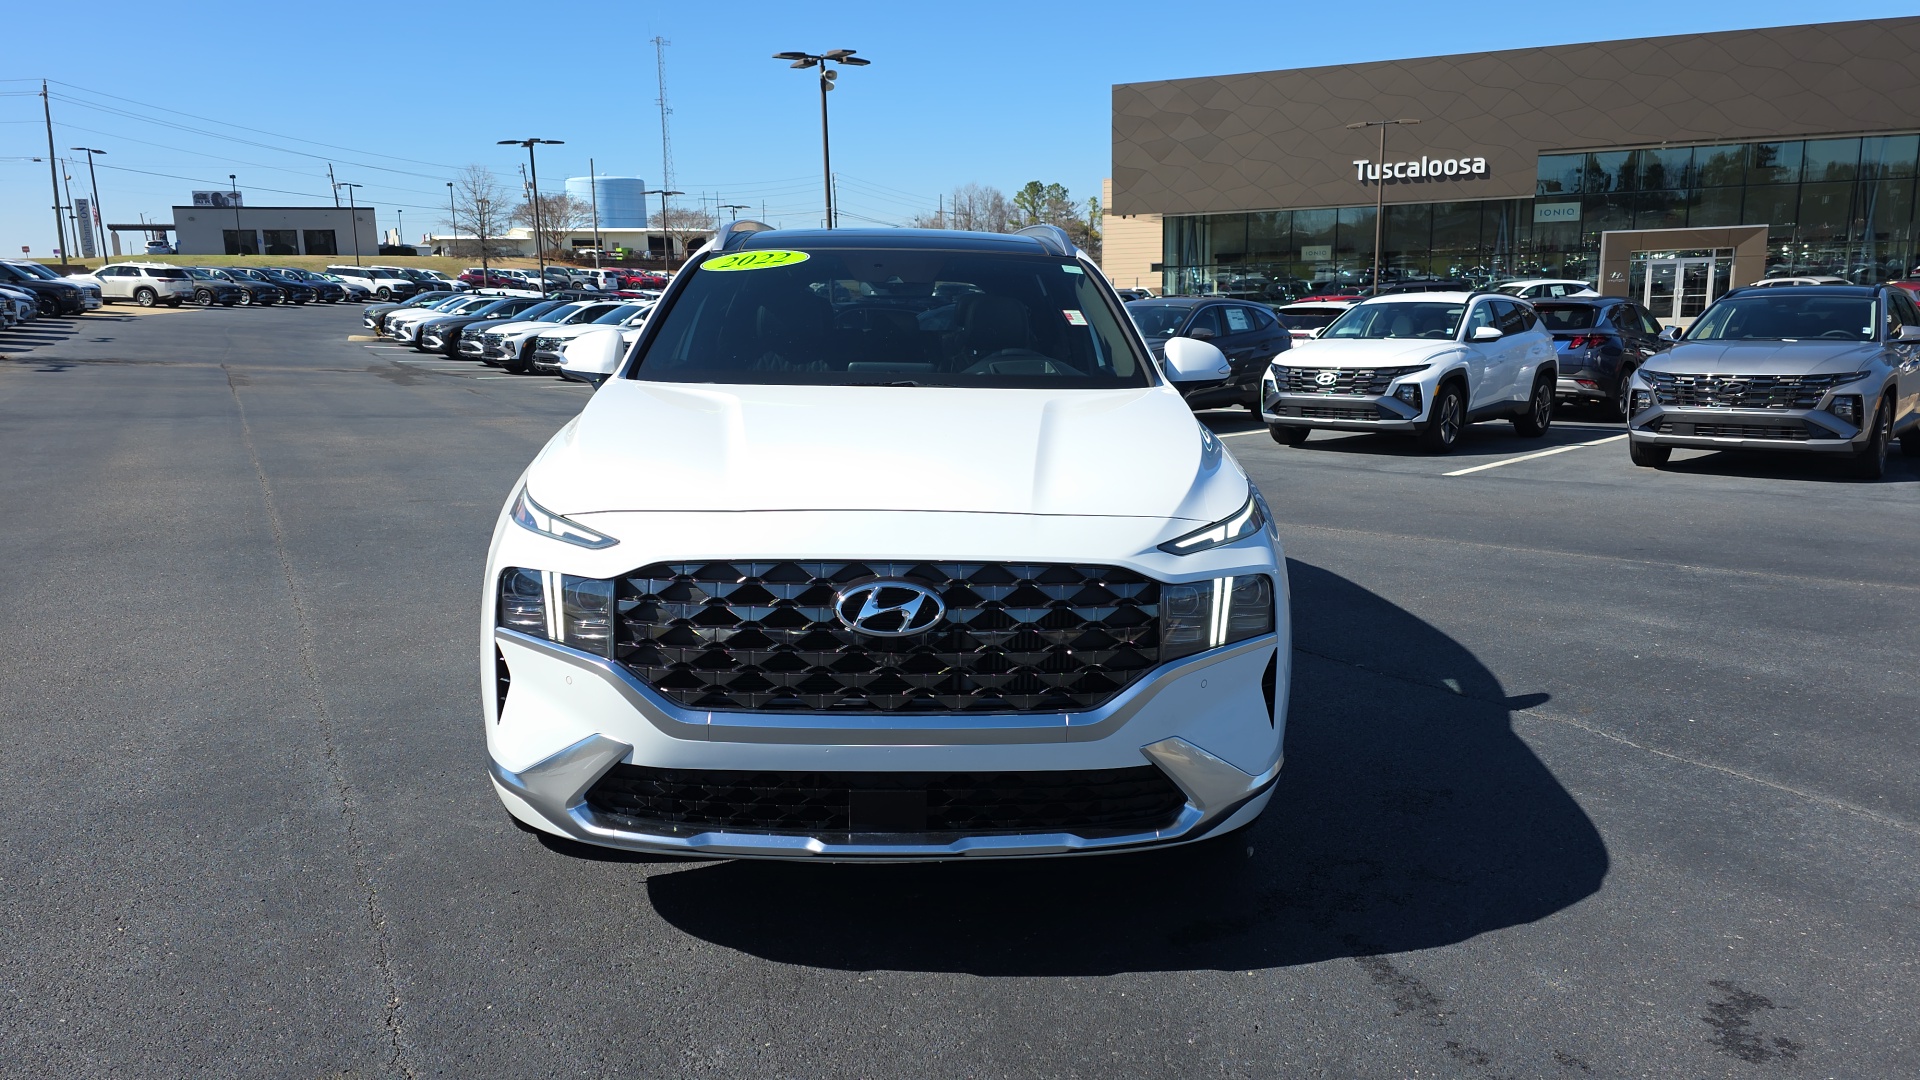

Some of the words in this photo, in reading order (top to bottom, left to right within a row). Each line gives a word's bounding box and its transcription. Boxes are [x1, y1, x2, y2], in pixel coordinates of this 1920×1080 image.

[1353, 156, 1486, 180] Tuscaloosa
[78, 199, 88, 219] ONE
[1539, 208, 1575, 217] IONIQ
[83, 219, 93, 253] Alabama
[718, 253, 791, 268] 2022
